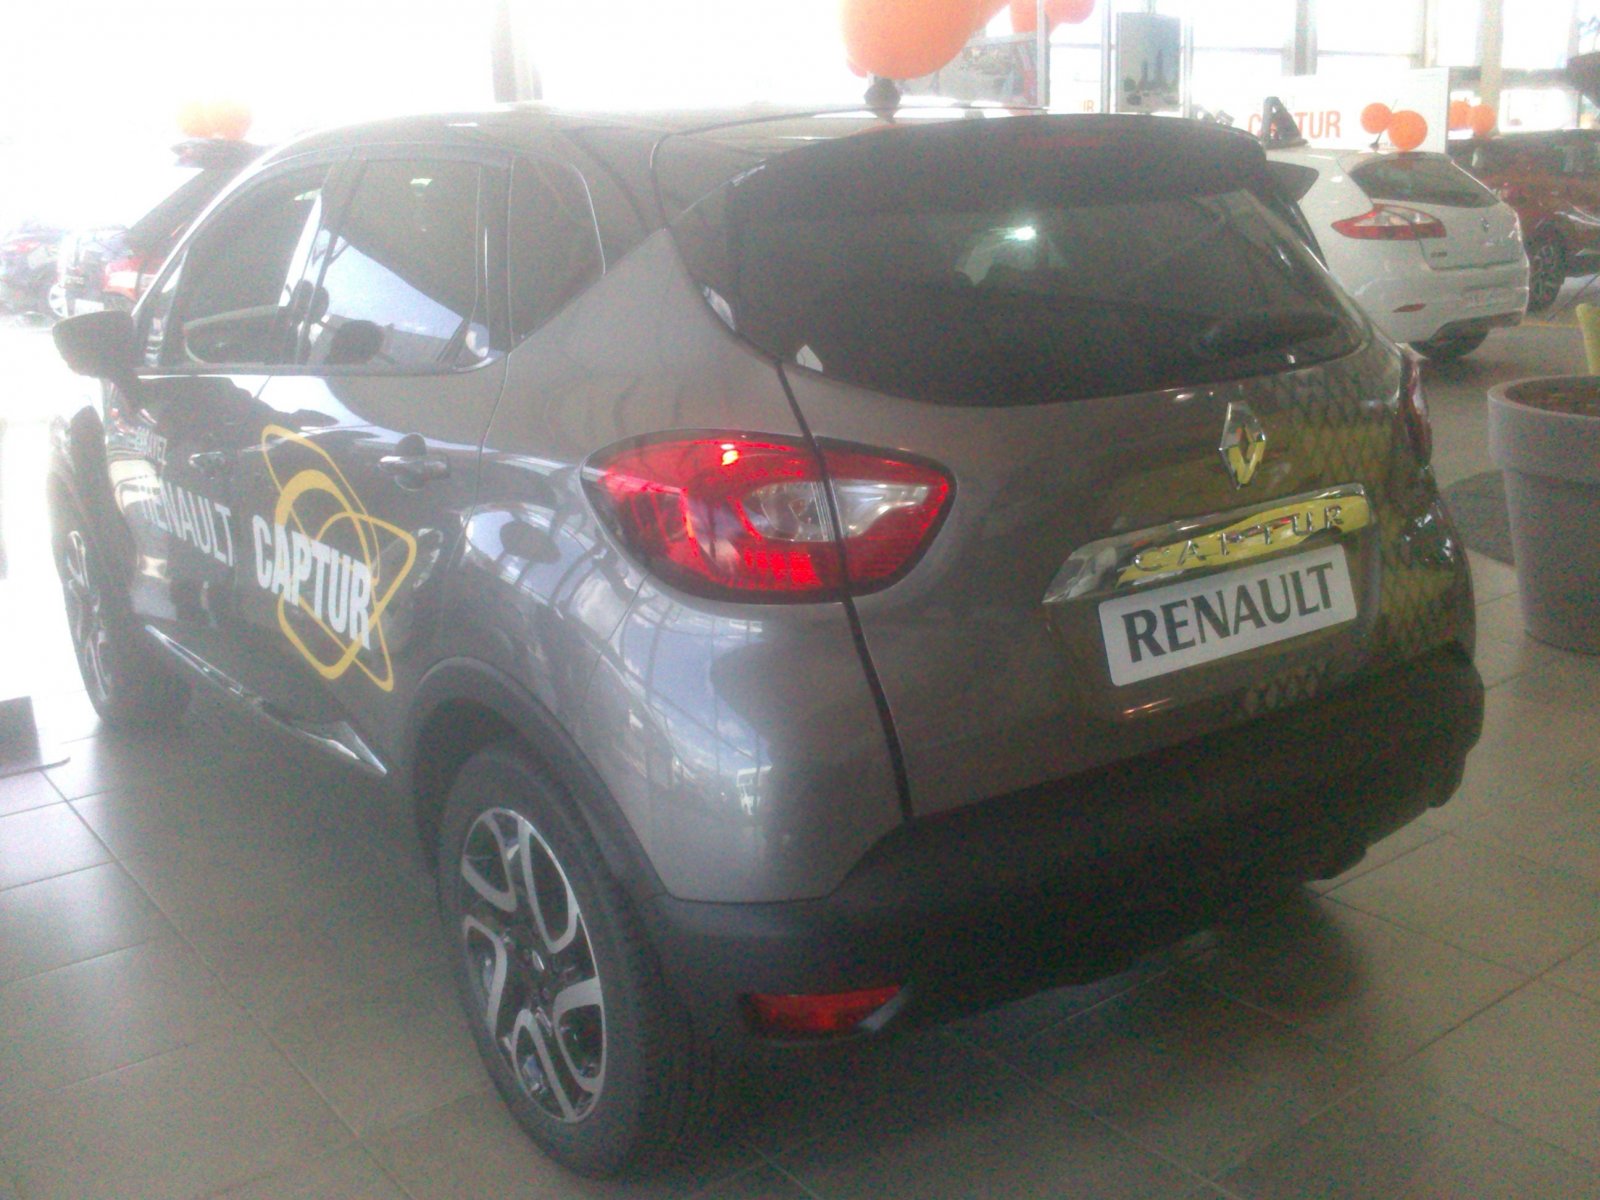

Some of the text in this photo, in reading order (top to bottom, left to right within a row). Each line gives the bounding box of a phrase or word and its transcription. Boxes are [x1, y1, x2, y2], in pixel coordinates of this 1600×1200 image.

[1247, 110, 1341, 139] CTUR
[252, 514, 371, 650] CAPTUR
[1121, 562, 1333, 663] RENAULT
